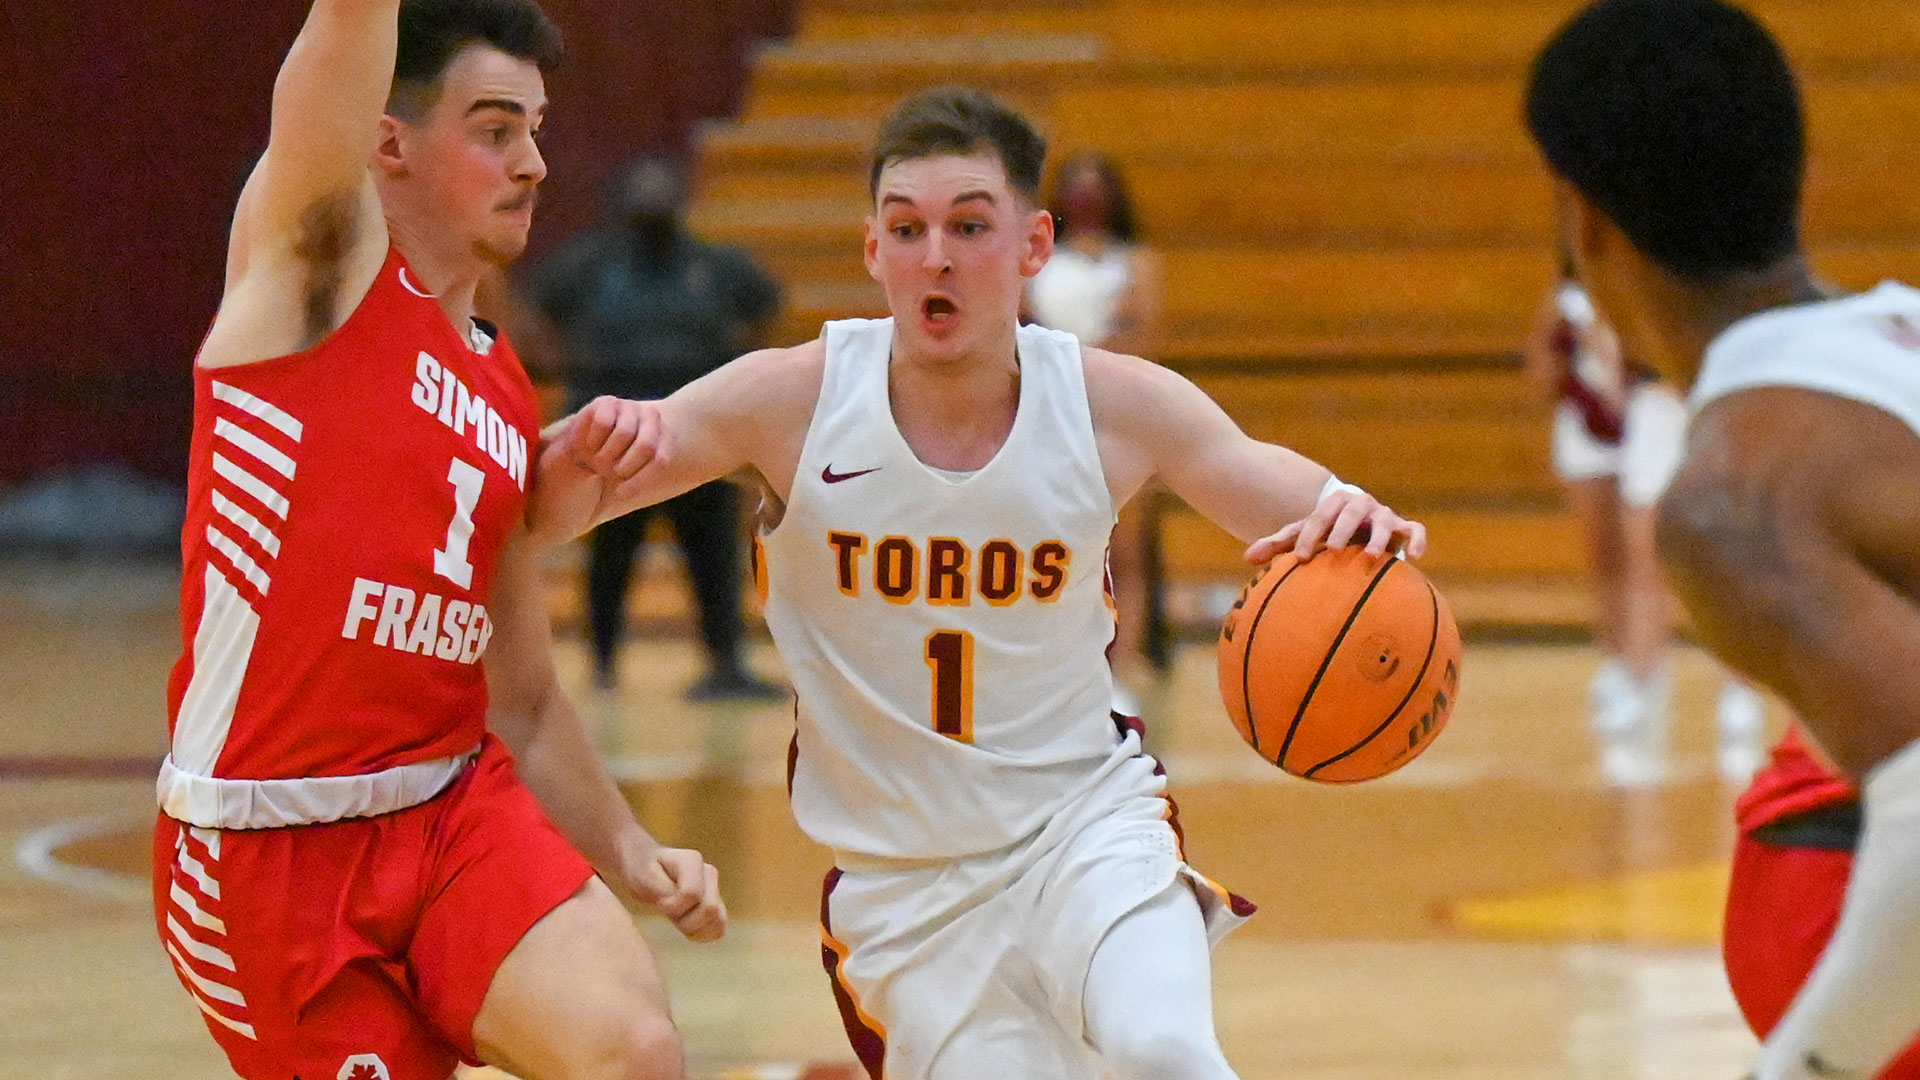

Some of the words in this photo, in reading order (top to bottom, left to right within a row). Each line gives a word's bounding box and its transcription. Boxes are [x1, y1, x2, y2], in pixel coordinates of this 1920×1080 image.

[411, 351, 527, 493] SIMON
[434, 456, 486, 591] 1
[827, 530, 1072, 607] TOROS
[924, 628, 975, 744] 1
